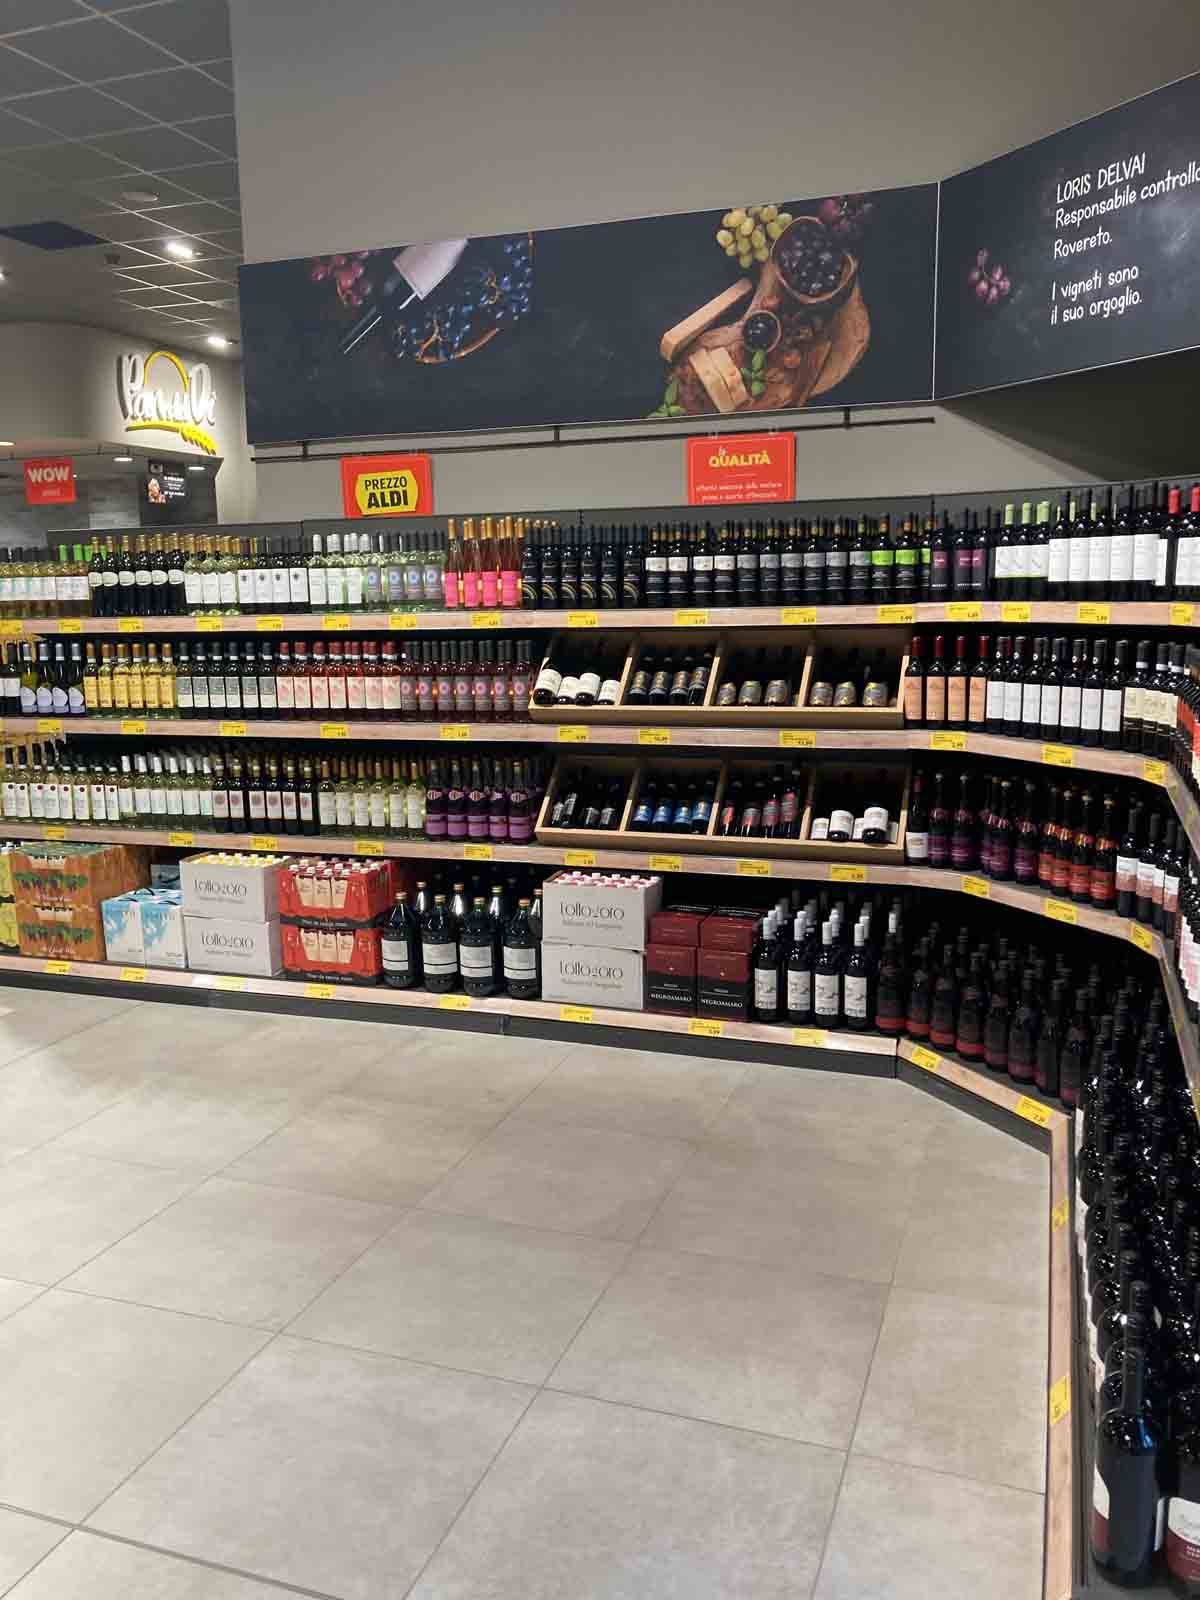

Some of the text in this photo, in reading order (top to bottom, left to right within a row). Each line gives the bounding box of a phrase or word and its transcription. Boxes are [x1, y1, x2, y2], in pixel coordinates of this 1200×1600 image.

[1056, 152, 1146, 204] LORIS DELVAI
[1055, 184, 1137, 229] Responsabile
[1054, 225, 1113, 260] Rovereto.
[1052, 265, 1139, 302] I vigneti sono
[1051, 286, 1143, 326] il suo orgoglio.
[708, 450, 772, 468] QUALITÀ
[26, 466, 71, 483] WOW
[364, 477, 408, 491] PREZZO
[367, 490, 409, 509] ALDI
[651, 993, 692, 1002] NEGROAMARO
[702, 998, 743, 1008] NEGROAMARO
